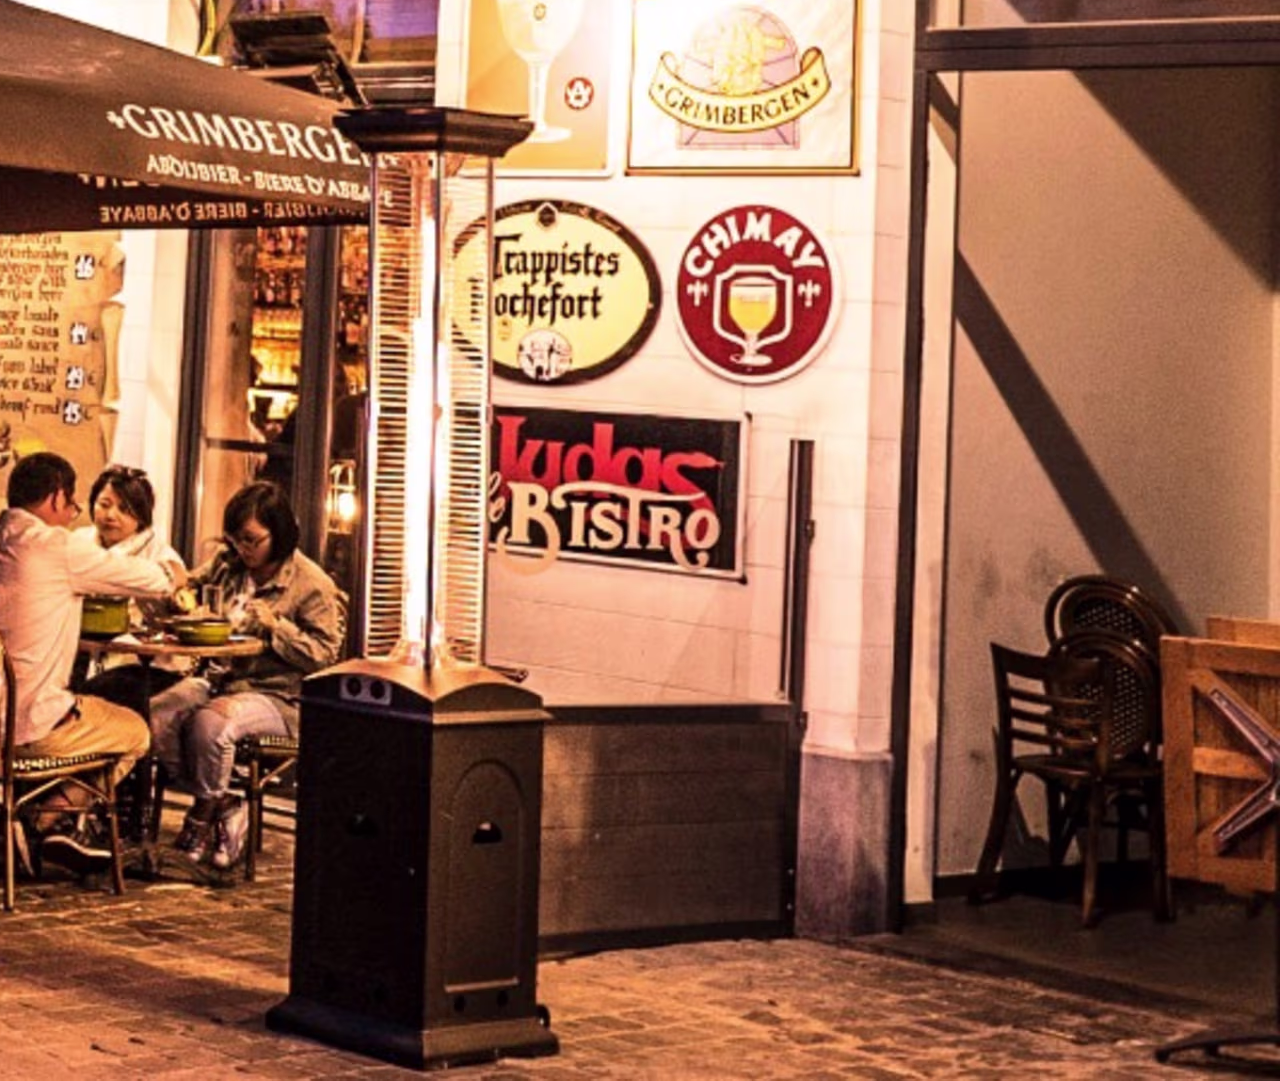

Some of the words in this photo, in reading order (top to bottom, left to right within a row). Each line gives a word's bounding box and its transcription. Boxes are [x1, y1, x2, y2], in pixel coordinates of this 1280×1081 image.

[665, 83, 811, 126] GRIMBERGEN
[122, 104, 385, 169] GRIMBERGE
[252, 170, 306, 194] BIERE
[493, 233, 621, 287] Trappistes
[685, 211, 826, 278] CHIMAY
[494, 282, 603, 326] ochefort
